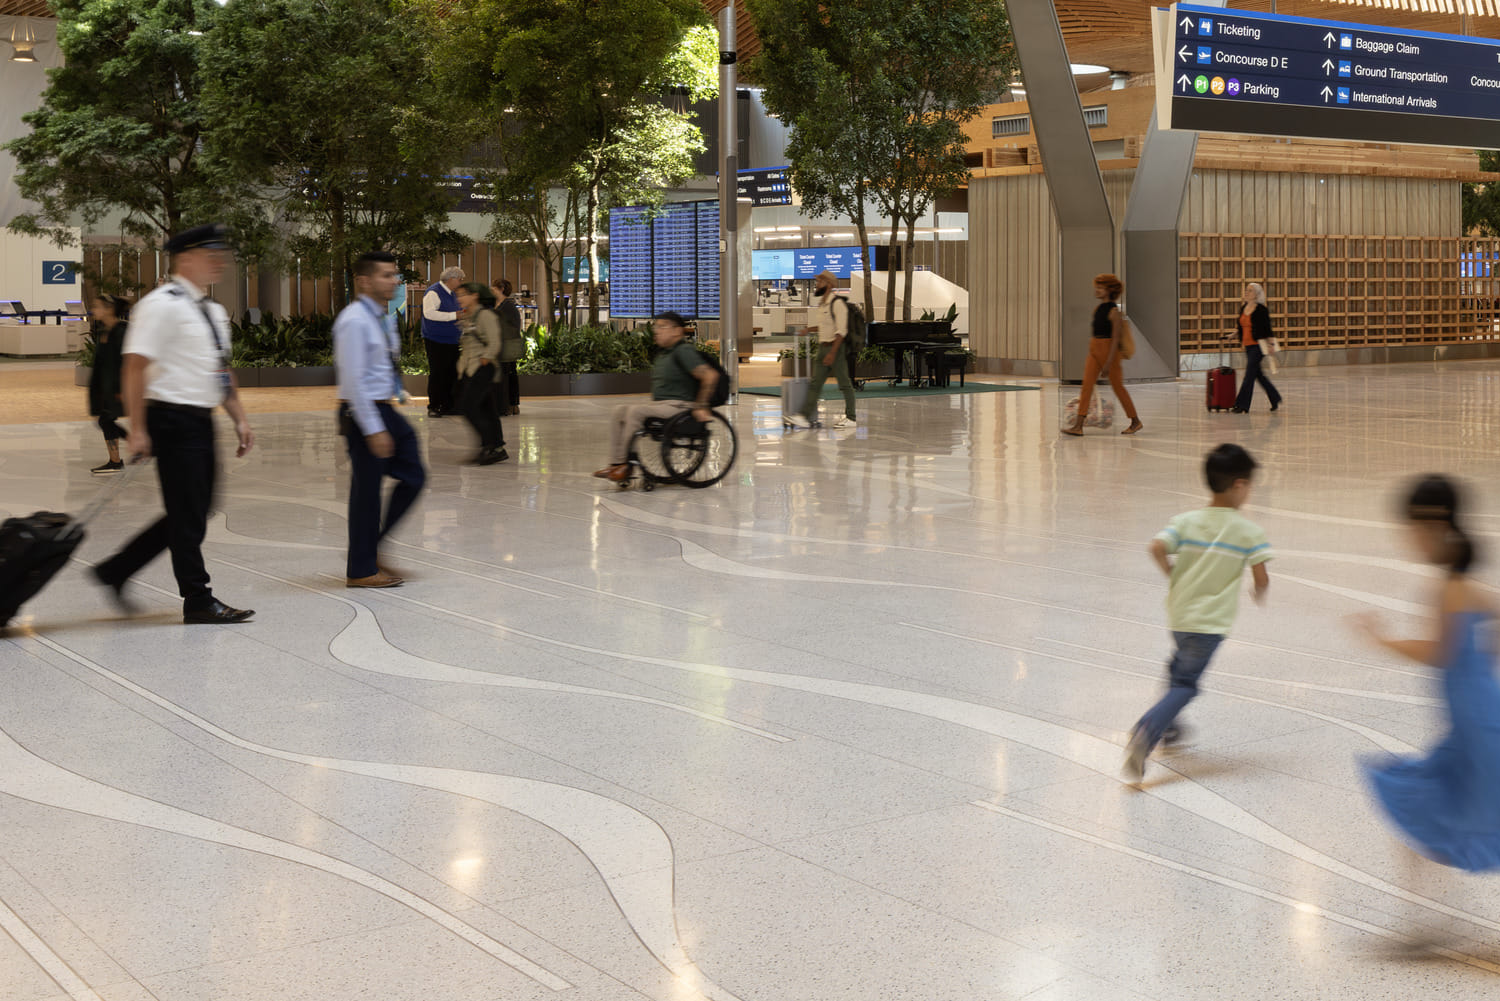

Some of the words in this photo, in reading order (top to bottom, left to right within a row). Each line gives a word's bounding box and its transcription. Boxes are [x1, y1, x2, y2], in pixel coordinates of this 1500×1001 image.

[1217, 22, 1261, 40] Ticketing
[1355, 38, 1394, 54] Baggage
[1396, 42, 1420, 55] Claim
[1215, 51, 1268, 67] Concourse
[1271, 57, 1279, 67] D
[1281, 57, 1289, 69] E
[1354, 65, 1387, 78] Ground
[1389, 68, 1448, 83] Transportation
[1196, 80, 1207, 90] P1
[1212, 81, 1224, 91] P2
[1228, 82, 1240, 92] P3
[1243, 82, 1280, 98] Parking
[1352, 91, 1405, 106] International
[1406, 96, 1437, 109] Arrivals
[52, 263, 66, 281] 2
